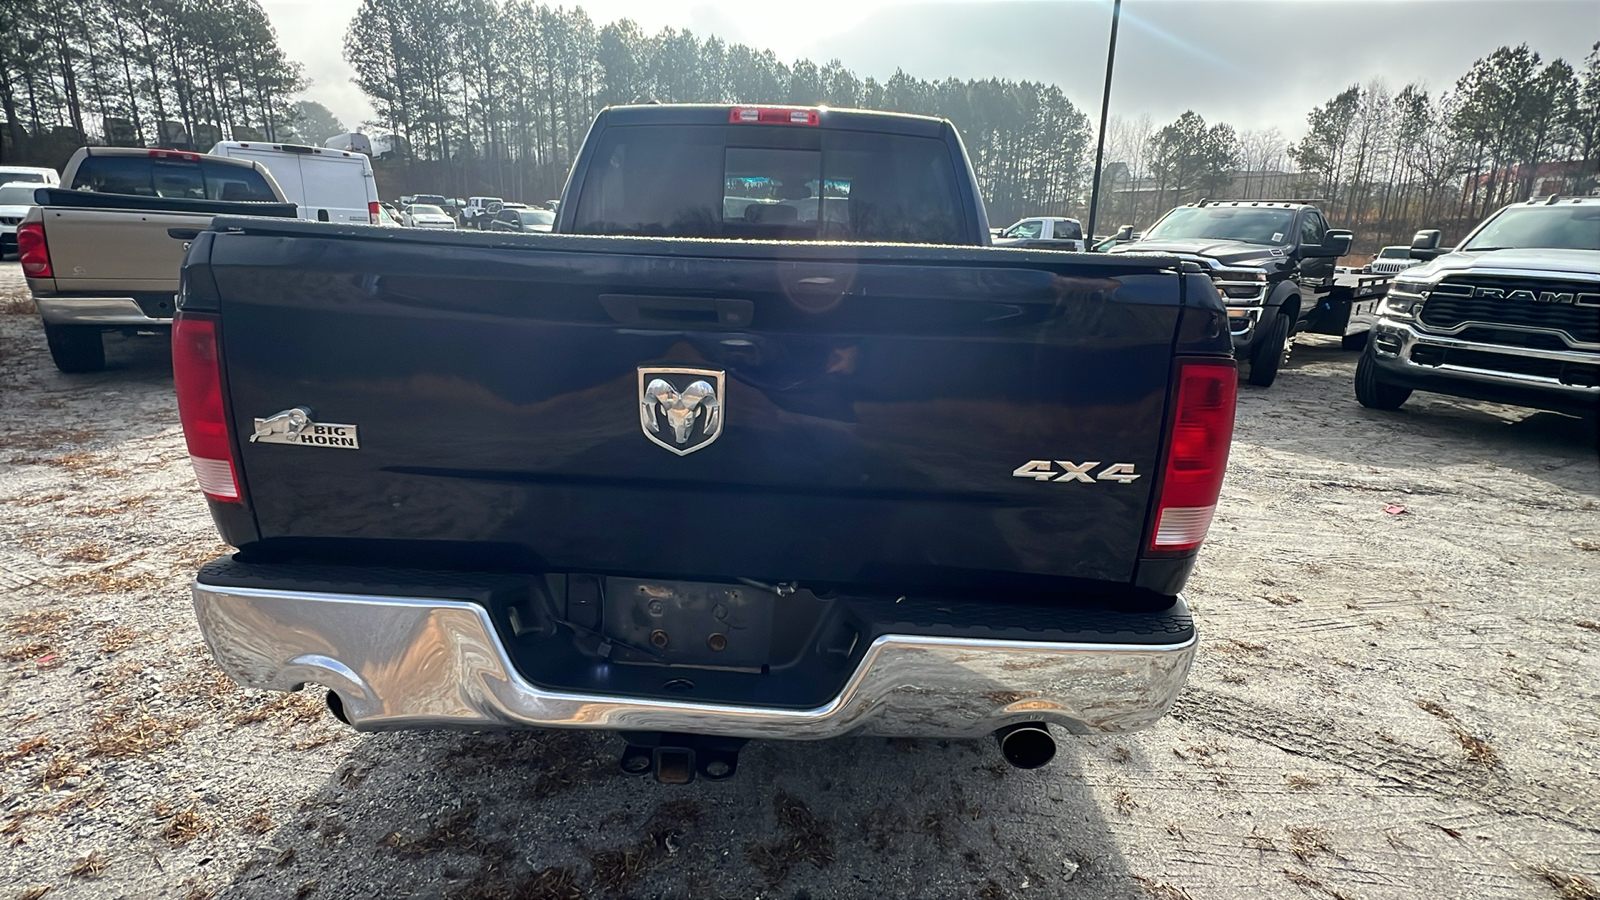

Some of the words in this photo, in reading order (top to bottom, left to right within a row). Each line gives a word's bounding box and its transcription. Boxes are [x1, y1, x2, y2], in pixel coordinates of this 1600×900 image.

[1475, 287, 1574, 304] RAM
[314, 425, 346, 436] BIG
[301, 435, 354, 446] HORN
